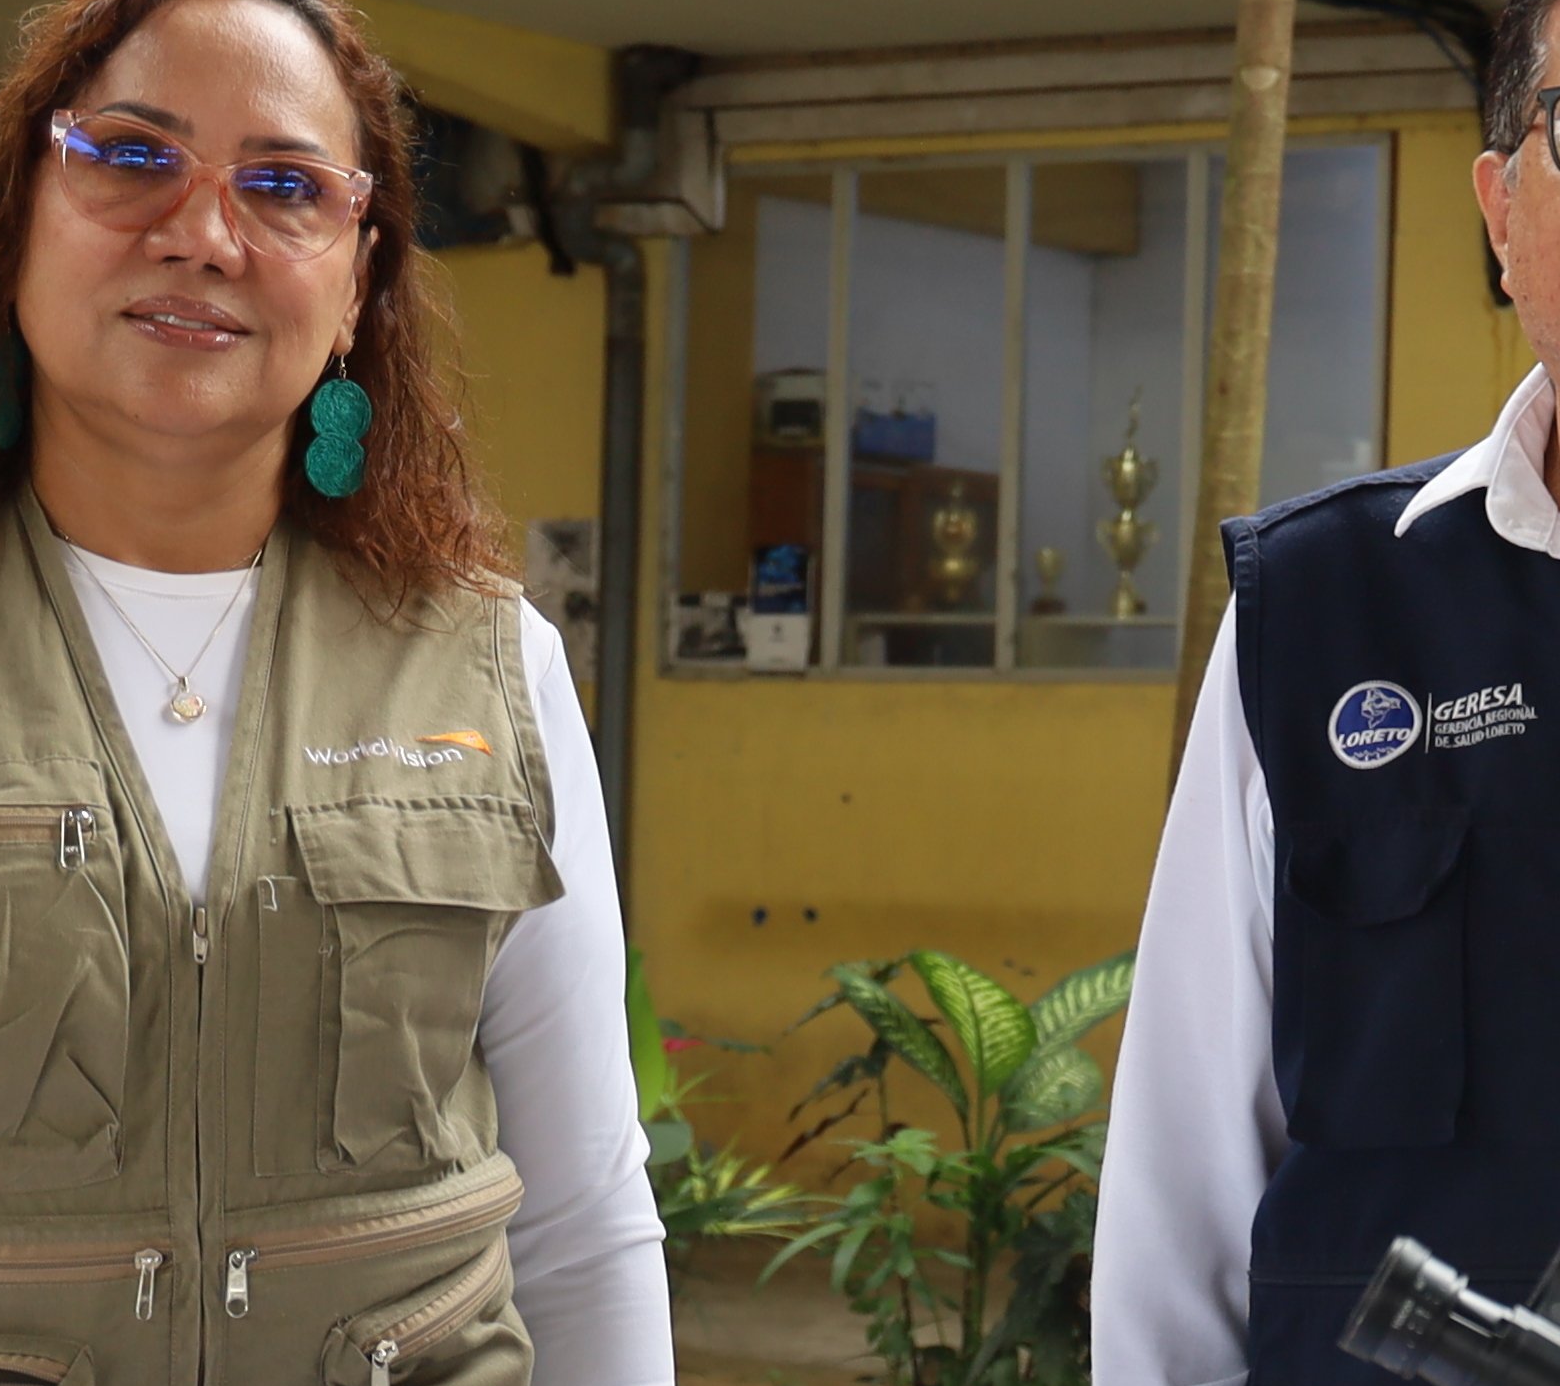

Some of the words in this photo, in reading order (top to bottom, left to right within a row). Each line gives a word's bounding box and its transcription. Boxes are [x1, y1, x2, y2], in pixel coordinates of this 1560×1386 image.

[1433, 683, 1523, 721] GERESA
[1434, 716, 1484, 735] GERENCIA
[1484, 706, 1538, 727] REGIONAL
[304, 737, 389, 766] World
[389, 738, 463, 768] Vision
[1338, 728, 1412, 749] LORETO
